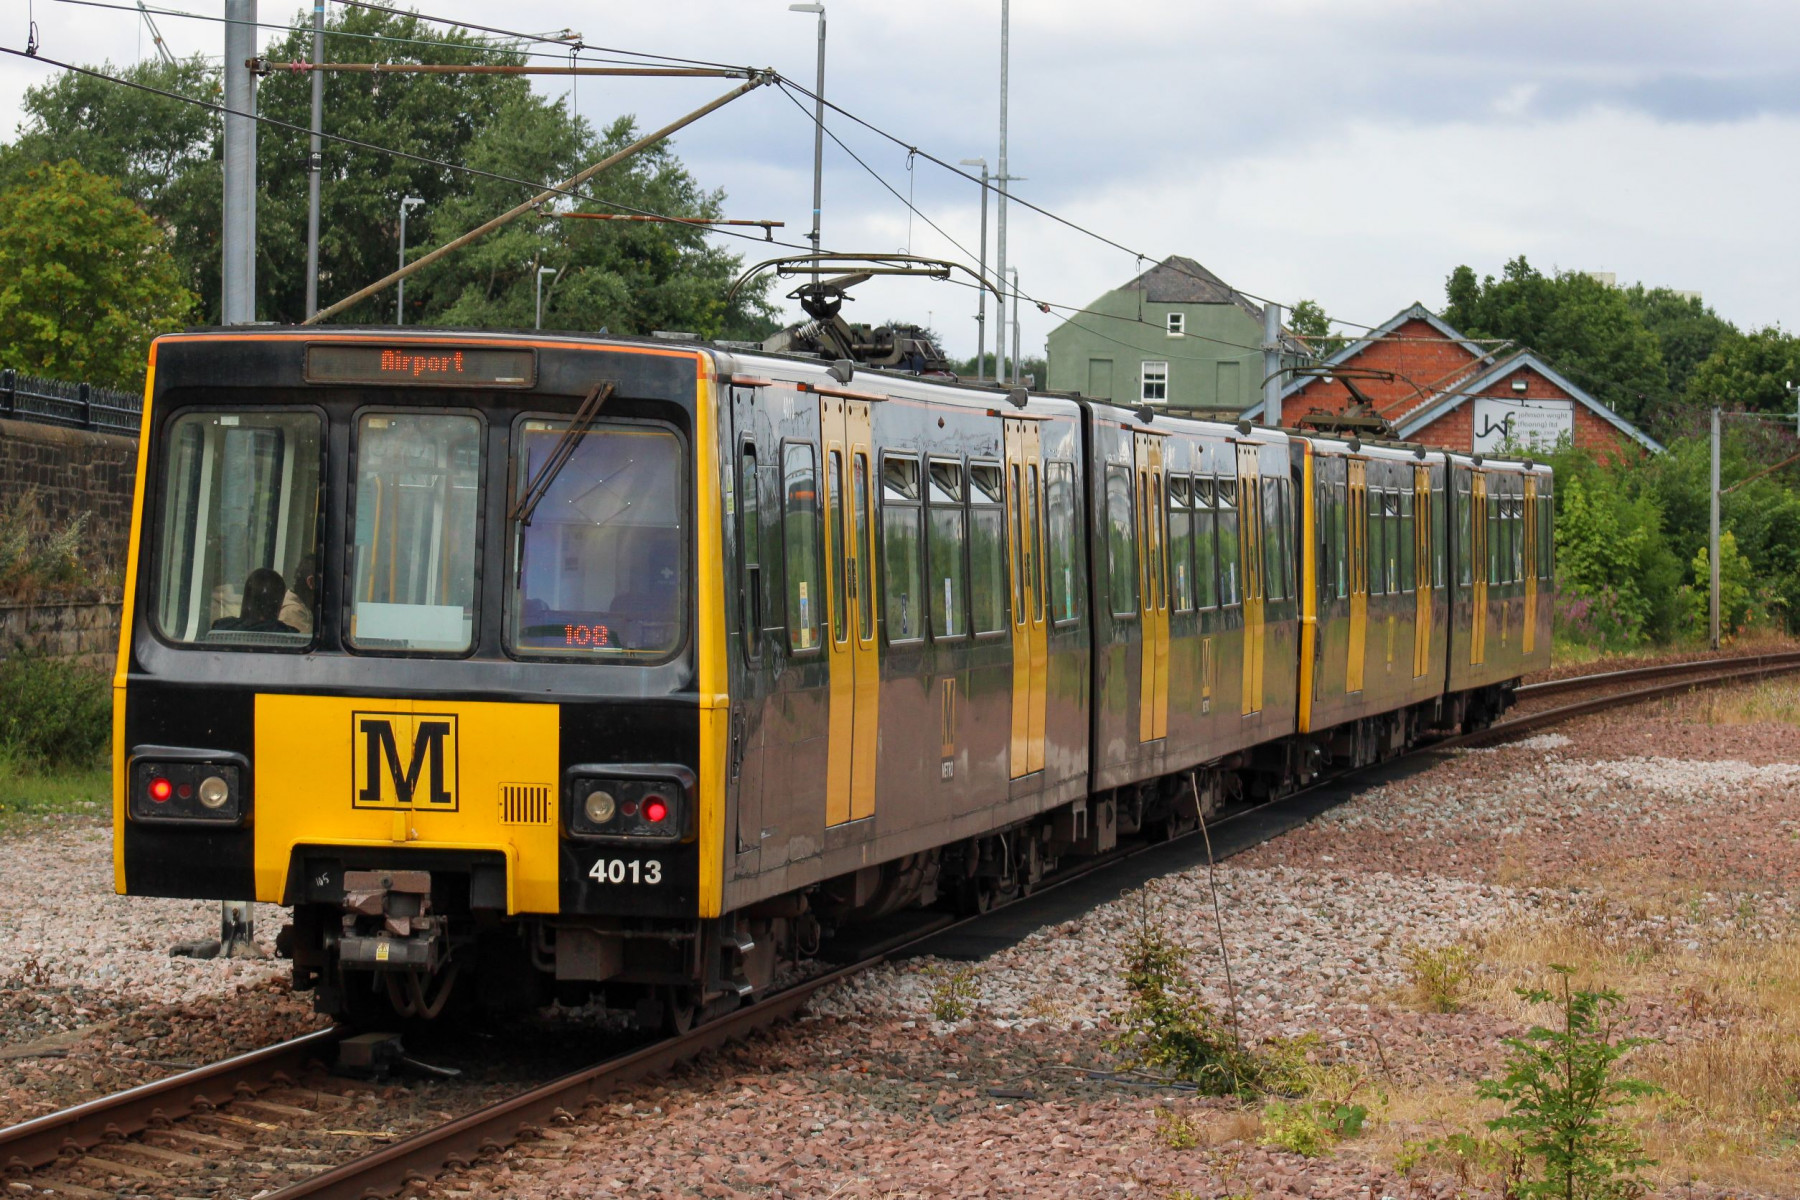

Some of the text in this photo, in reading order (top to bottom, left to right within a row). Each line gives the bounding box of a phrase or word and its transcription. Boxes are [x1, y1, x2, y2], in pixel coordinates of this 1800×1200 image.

[381, 350, 463, 376] Airport
[1518, 411, 1568, 420] johnson wright
[565, 624, 608, 645] 108
[359, 719, 452, 804] M
[588, 858, 662, 884] 4013
